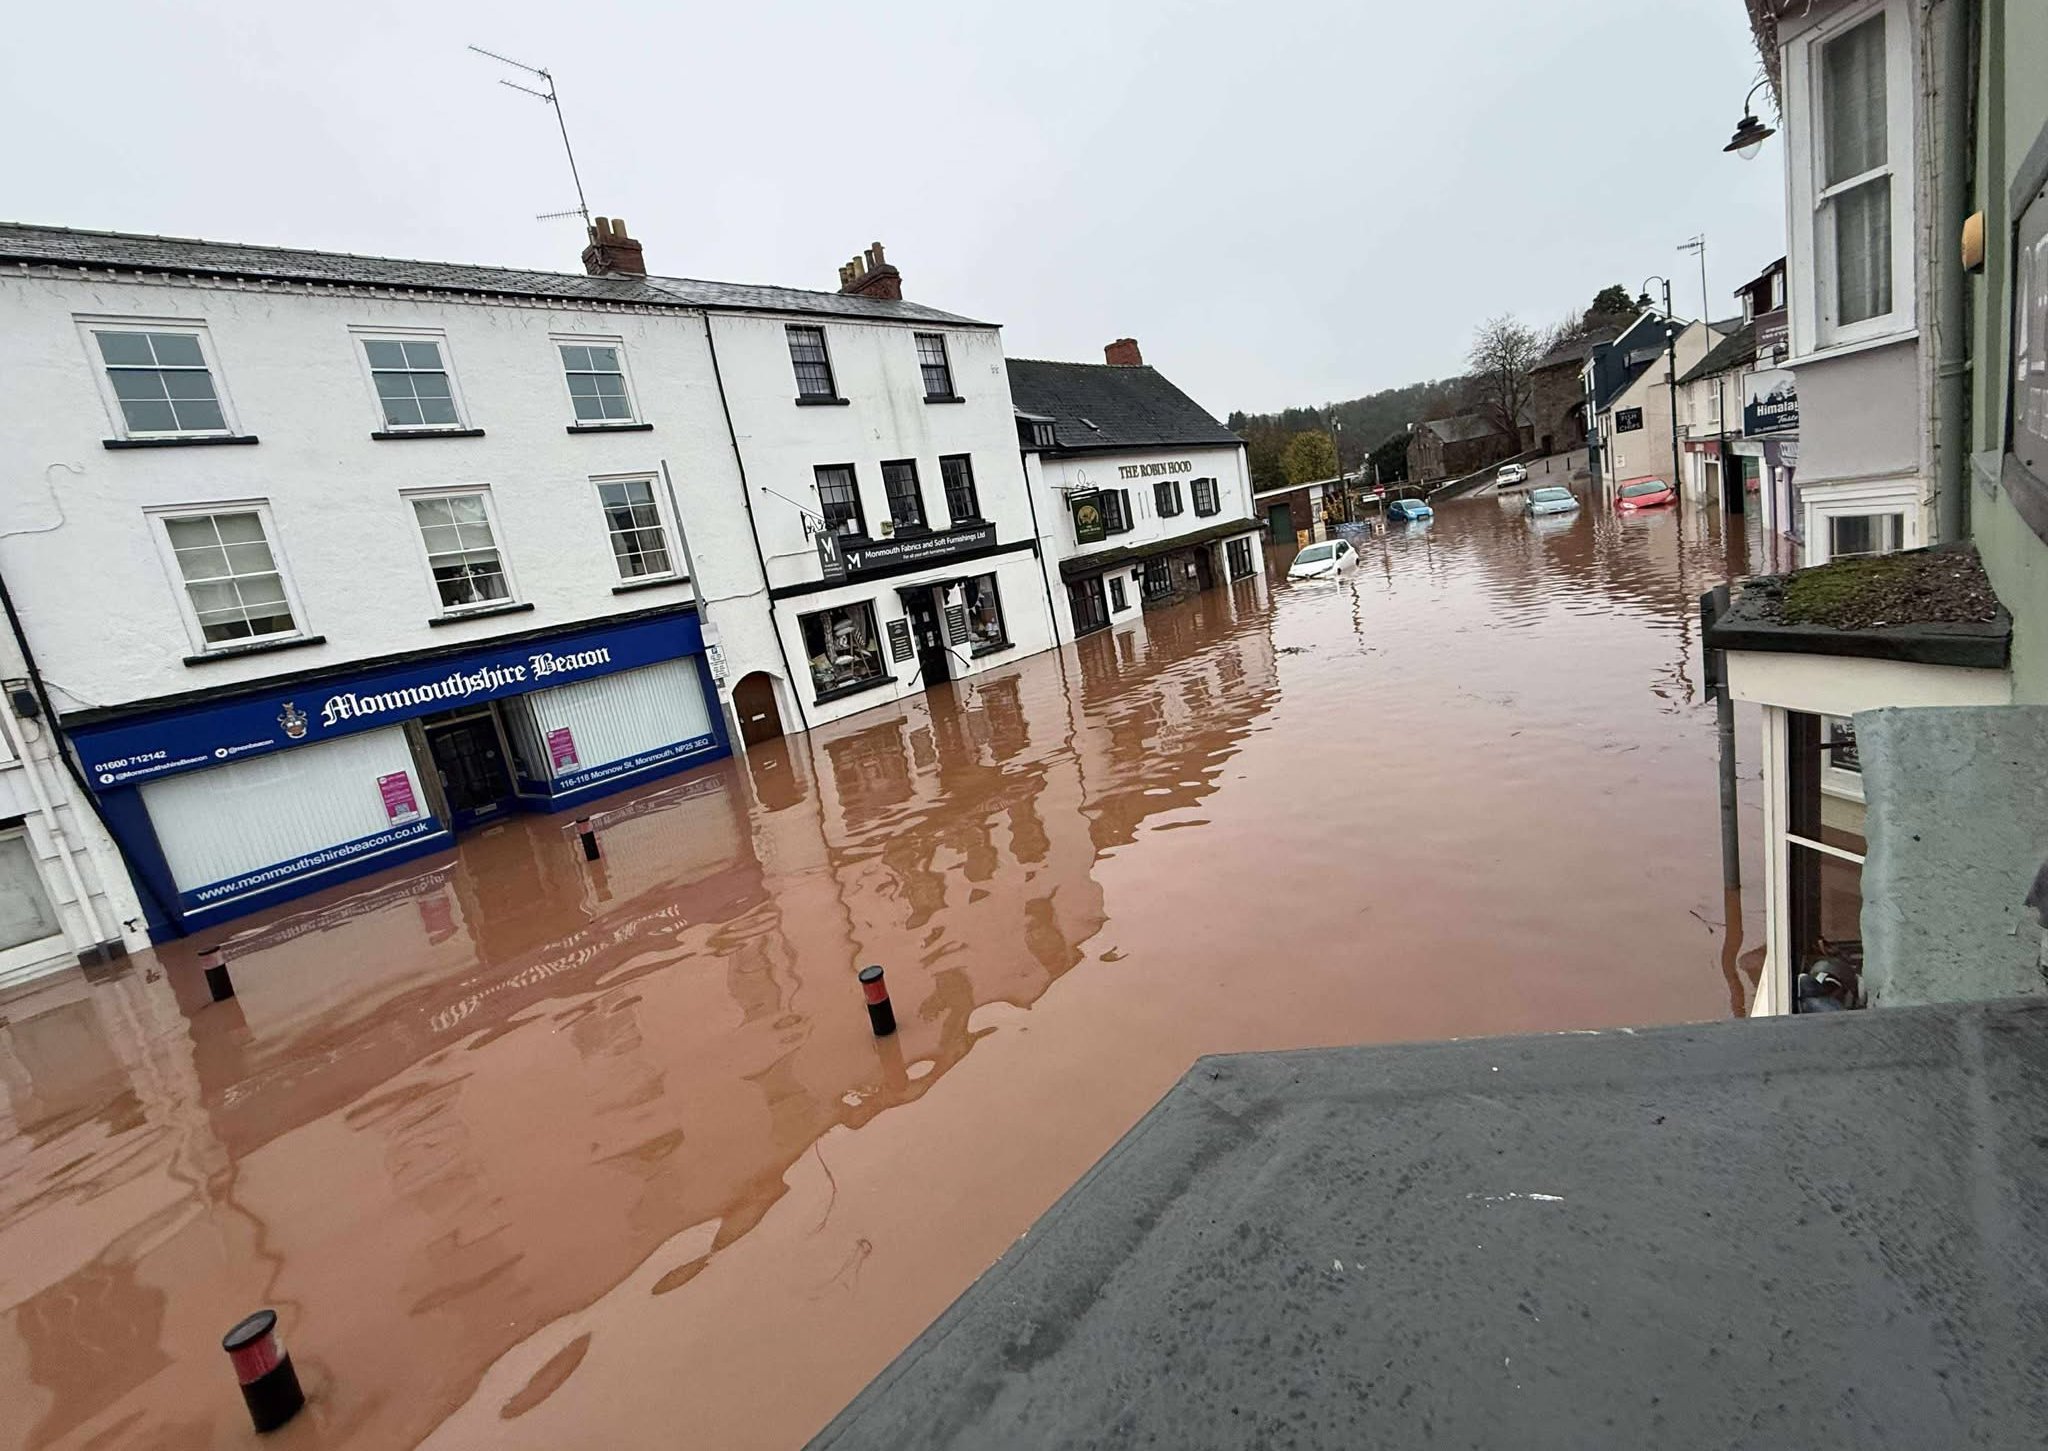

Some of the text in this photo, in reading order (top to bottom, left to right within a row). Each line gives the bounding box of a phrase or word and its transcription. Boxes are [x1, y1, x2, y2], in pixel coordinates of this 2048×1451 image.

[1118, 460, 1192, 479] THE ROBIN HOOD
[865, 531, 986, 559] Monmouth Fabrics and Soft Furnishings Ltd
[320, 647, 611, 728] Monmouthshire Beacon
[95, 750, 168, 773] 01600 712142
[559, 774, 590, 789] 116-118
[591, 765, 623, 781] Monnow
[675, 742, 694, 754] NP25
[694, 738, 709, 748] 3EQ
[197, 822, 429, 902] www.monmouthshirebeacon.co.uk
